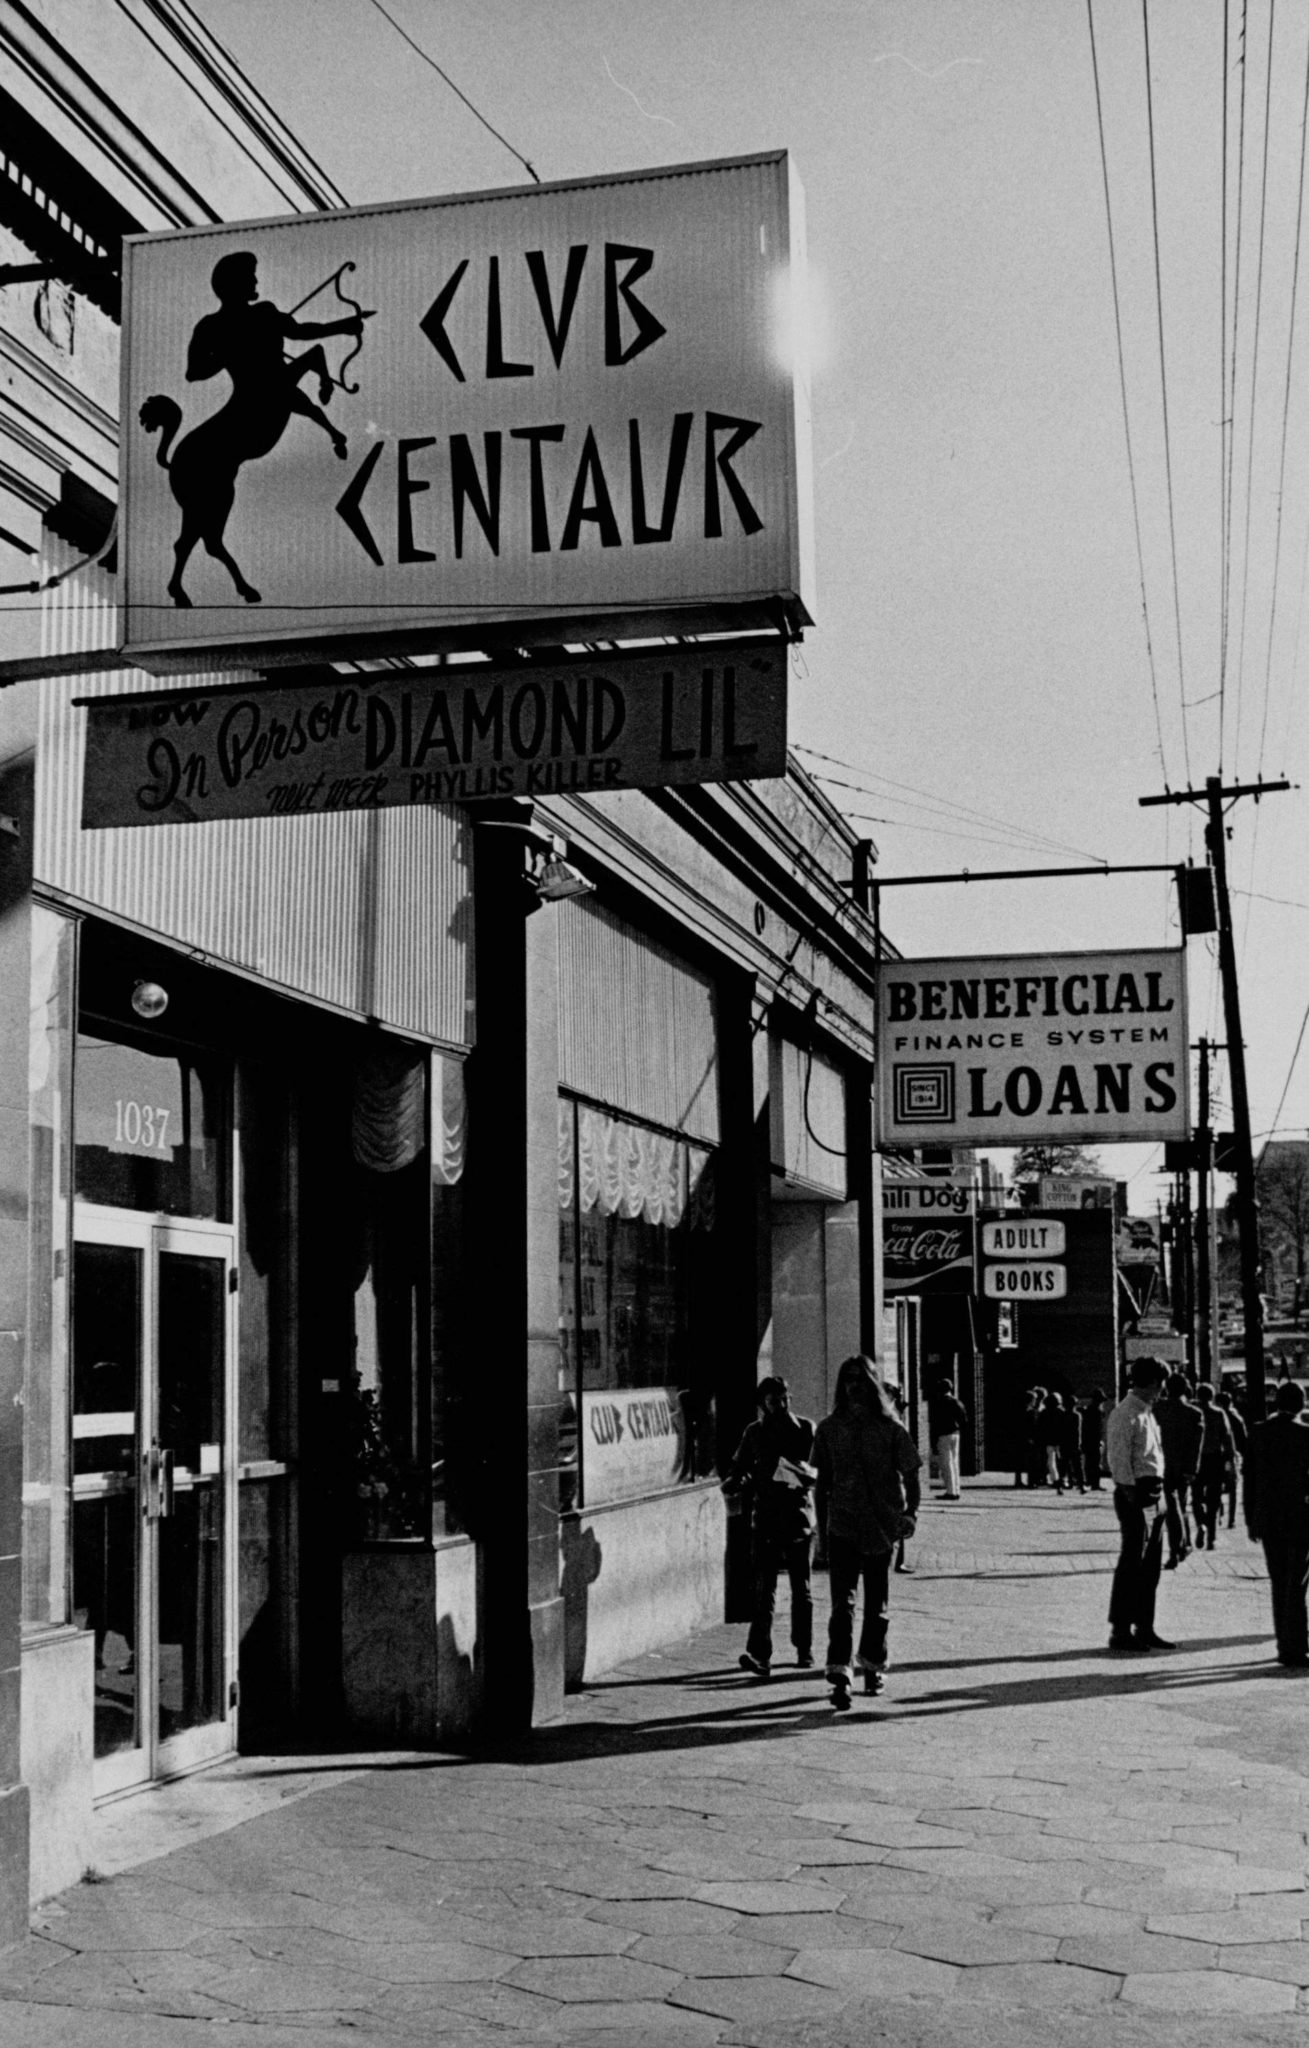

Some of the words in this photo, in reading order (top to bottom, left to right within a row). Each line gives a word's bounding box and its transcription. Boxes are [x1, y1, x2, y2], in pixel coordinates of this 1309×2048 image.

[335, 411, 764, 566] CENTAUR
[136, 738, 208, 811] In
[217, 689, 361, 788] Person
[365, 677, 626, 771] DIAMOND
[410, 766, 514, 801] PHYLLIS
[526, 757, 627, 794] KILLER
[887, 971, 1175, 1022] BENEFICIAL
[895, 1033, 1024, 1051] FINANCE
[1047, 1027, 1169, 1047] SYSTEM
[968, 1062, 1177, 1118] LOANS
[115, 1099, 170, 1149] 1037
[919, 1185, 968, 1214] Dog
[993, 1227, 1048, 1249] ADULT
[995, 1269, 1055, 1292] BOOKS
